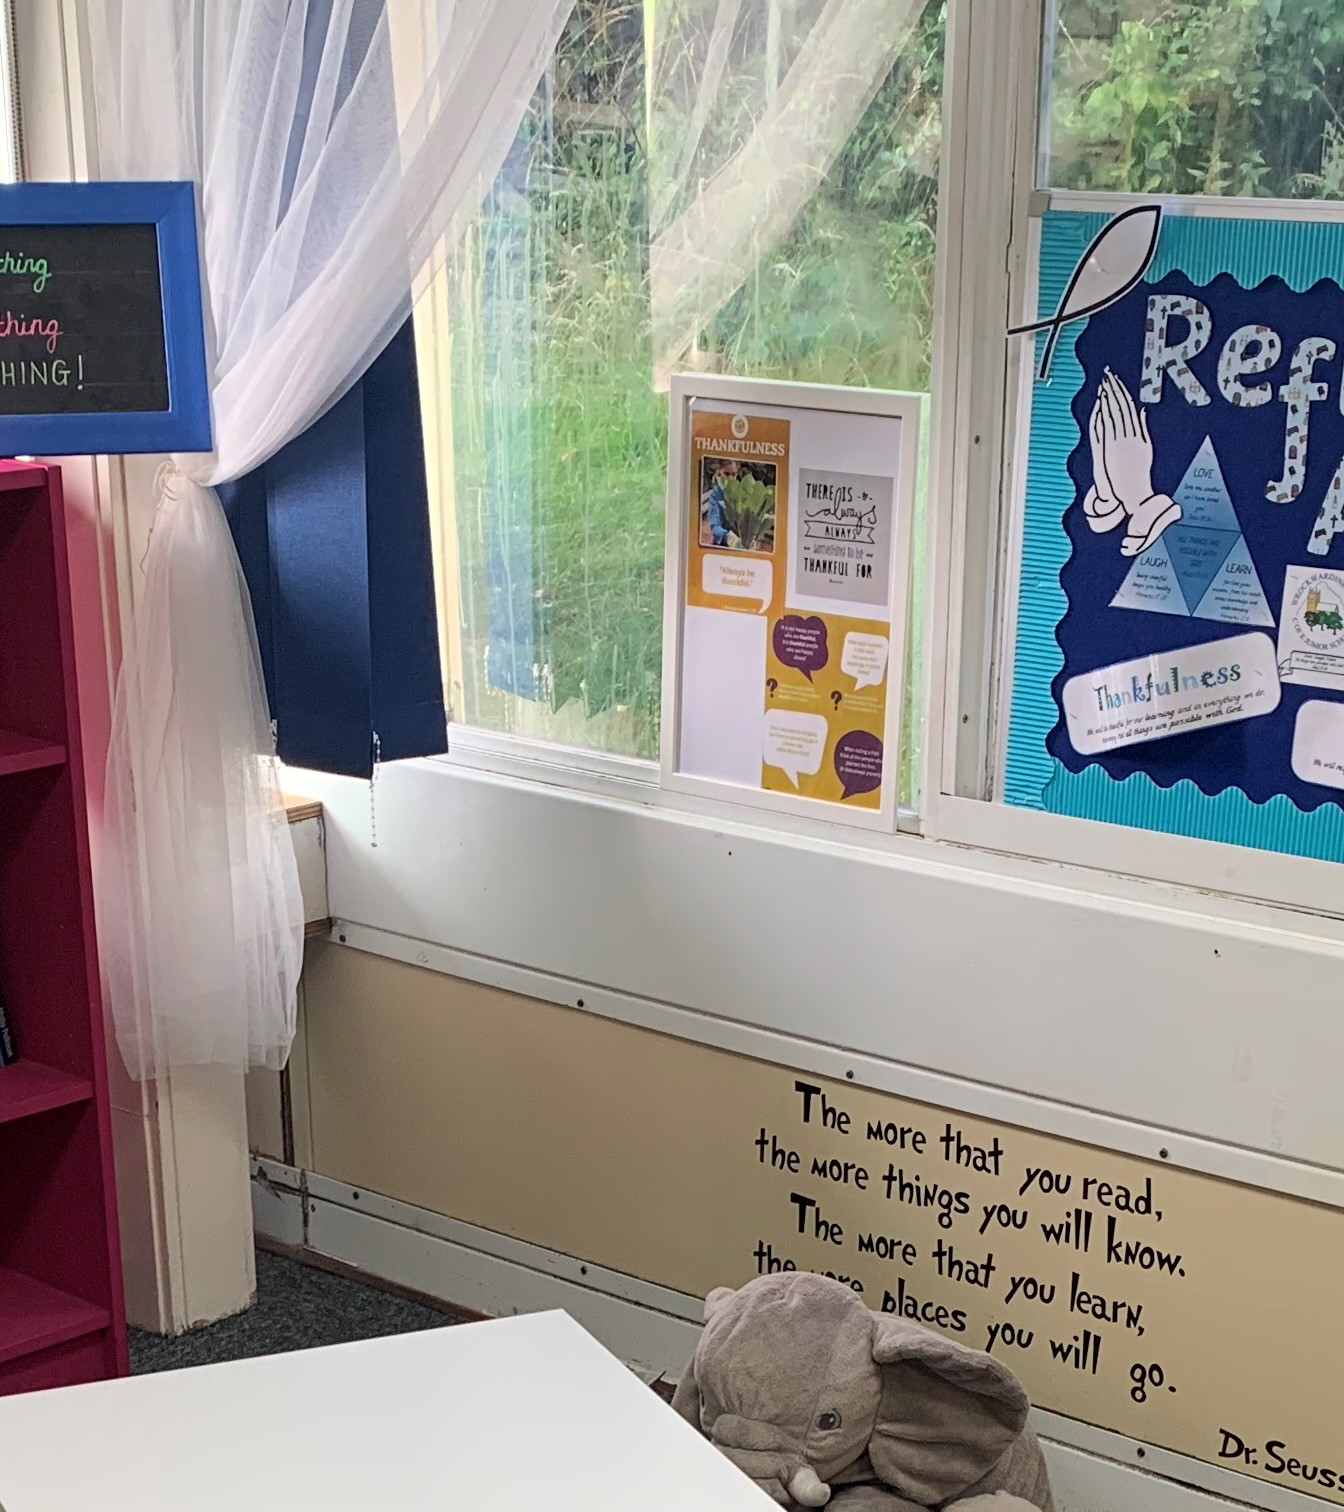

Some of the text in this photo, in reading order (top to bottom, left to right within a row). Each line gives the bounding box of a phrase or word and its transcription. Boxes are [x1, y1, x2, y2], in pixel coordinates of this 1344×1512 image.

[694, 437, 785, 456] THANKFULNESS
[1193, 467, 1214, 479] LOVE
[806, 483, 853, 502] THERE IS
[825, 526, 856, 539] ALWAYS
[804, 557, 872, 579] THANKFUL FOR
[1140, 556, 1168, 569] LAUGH
[1226, 562, 1253, 575] LEARN
[1304, 637, 1329, 650] JUNIOR
[1093, 664, 1242, 712] Thankfulness
[1145, 709, 1175, 724] learning
[1177, 703, 1192, 714] and
[1194, 702, 1202, 711] in
[1204, 694, 1241, 708] everything
[1125, 728, 1133, 738] all
[1133, 724, 1154, 737] things
[1155, 722, 1168, 730] are
[1168, 714, 1203, 730] possible
[1205, 709, 1223, 719] with
[1323, 760, 1335, 770] will
[794, 1080, 1164, 1223] The more that you read,
[755, 1127, 1186, 1278] the more things you will know.
[790, 1192, 1146, 1338] The more that you learn,
[753, 1240, 798, 1275] the
[881, 1277, 967, 1333] places
[985, 1321, 1034, 1354] you
[1049, 1330, 1101, 1375] will
[1129, 1362, 1177, 1404] go.
[1217, 1427, 1258, 1466] Dr.
